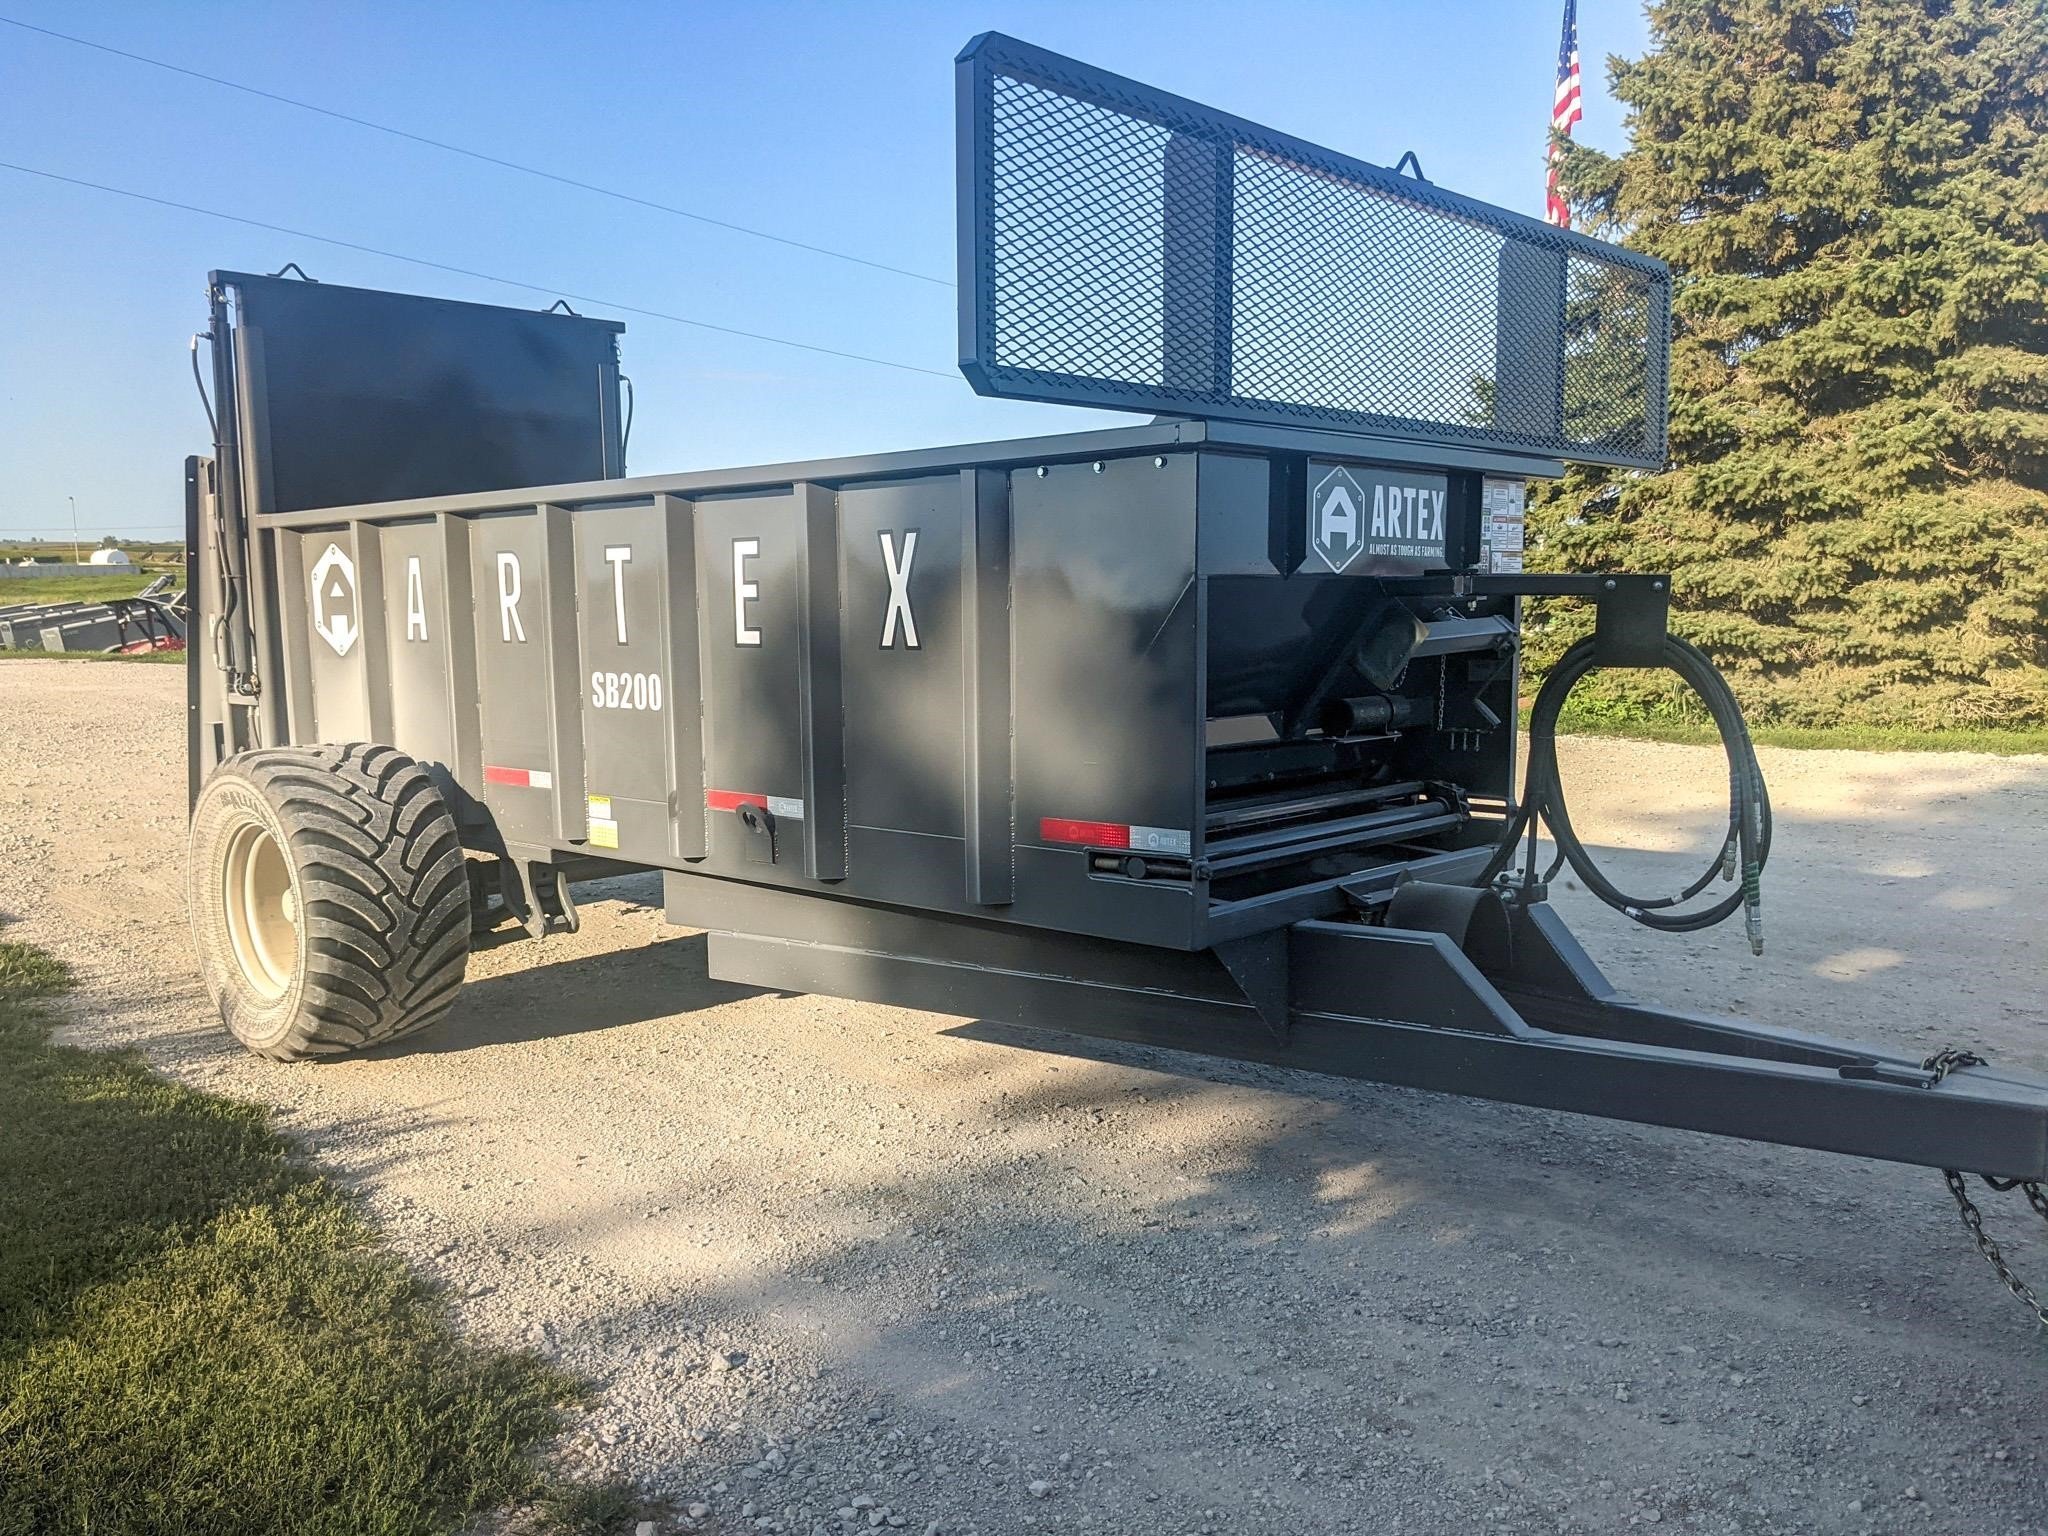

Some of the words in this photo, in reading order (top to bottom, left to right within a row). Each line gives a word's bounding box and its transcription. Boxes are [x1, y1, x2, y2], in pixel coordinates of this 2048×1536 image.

[1371, 485, 1444, 540] ARTEX
[1368, 543, 1390, 555] ALMOST
[1390, 544, 1397, 556] AS
[1398, 544, 1414, 556] TOUGH
[1414, 545, 1421, 557] AS
[591, 671, 662, 711] SB200
